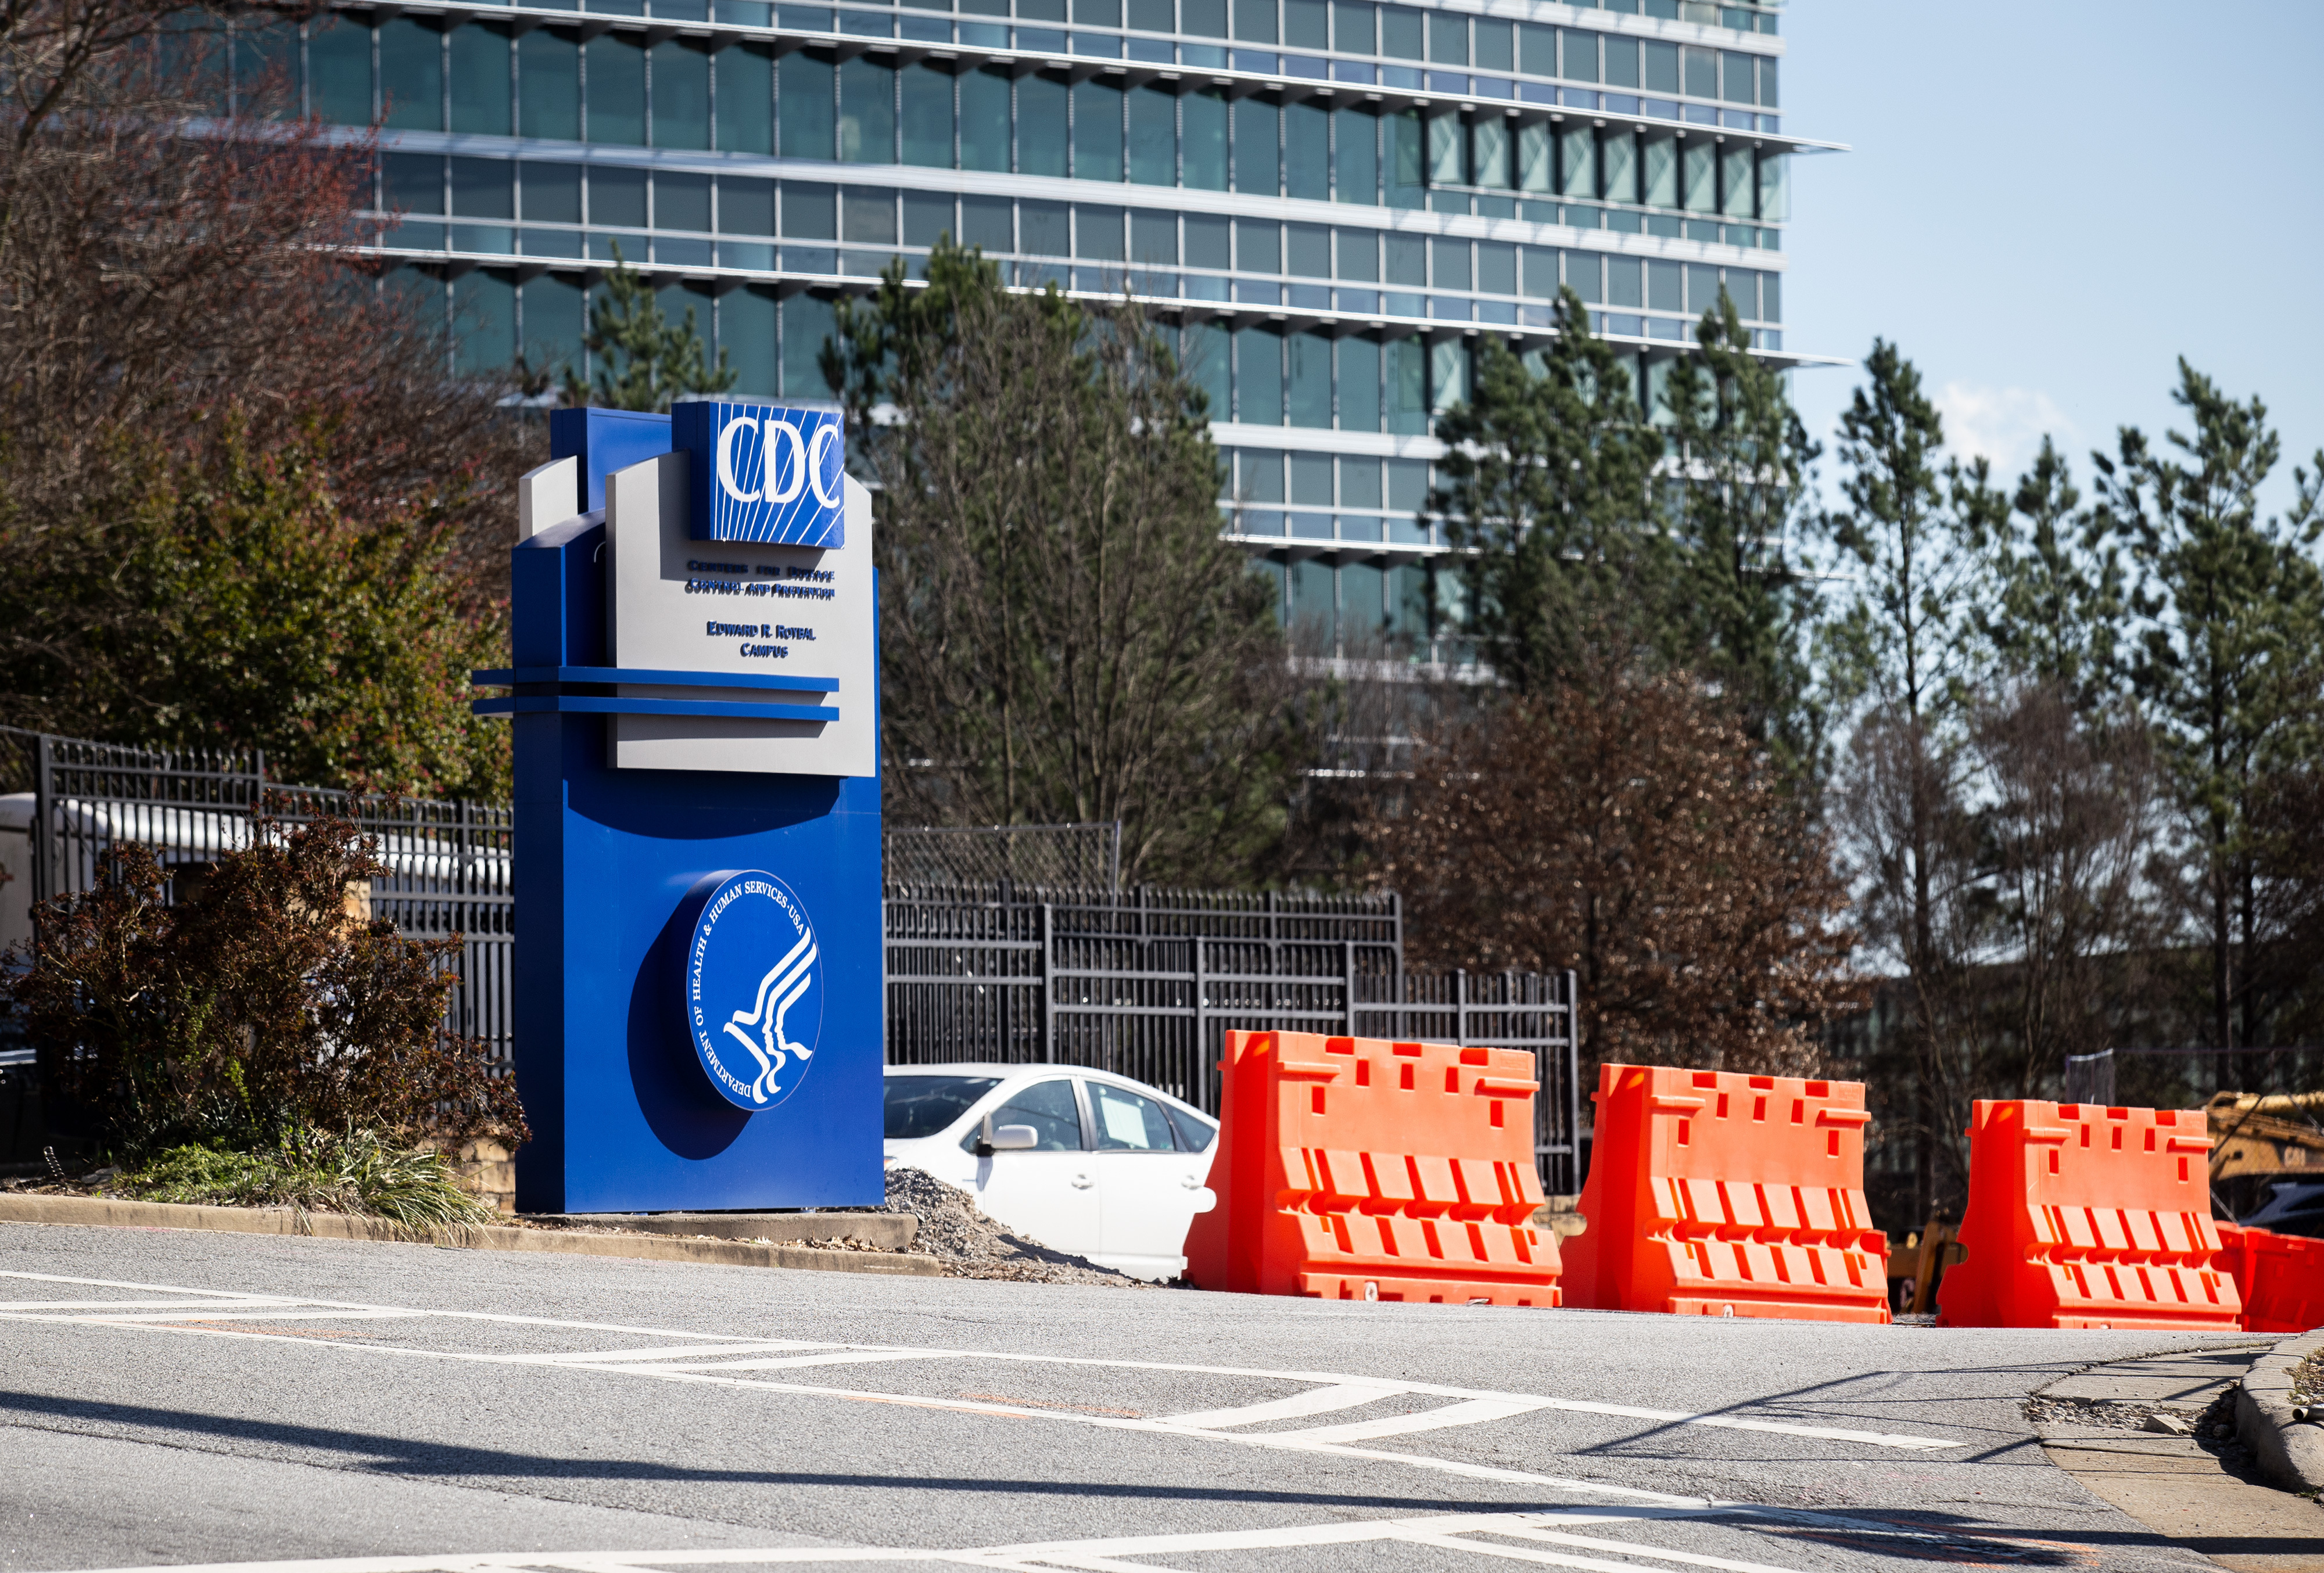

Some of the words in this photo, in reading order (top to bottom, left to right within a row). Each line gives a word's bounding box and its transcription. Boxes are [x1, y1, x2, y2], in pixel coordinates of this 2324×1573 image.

[717, 416, 840, 509] CDC
[690, 560, 749, 574] CENTERS
[759, 565, 781, 576] FOR
[791, 566, 835, 580] DISEASE
[690, 577, 744, 591] CONTROL
[749, 583, 771, 593] AND
[776, 583, 835, 597] PREVENTION
[708, 620, 759, 636] EDWARD
[762, 624, 773, 638] R.
[777, 624, 816, 640] ROYBAL
[741, 642, 788, 658] CAMPUS
[708, 882, 743, 924] HUMAN
[703, 924, 712, 936] &
[693, 936, 707, 1001] HEALTH
[694, 1005, 704, 1026] OF
[698, 1030, 752, 1098] DEPARTMENT
